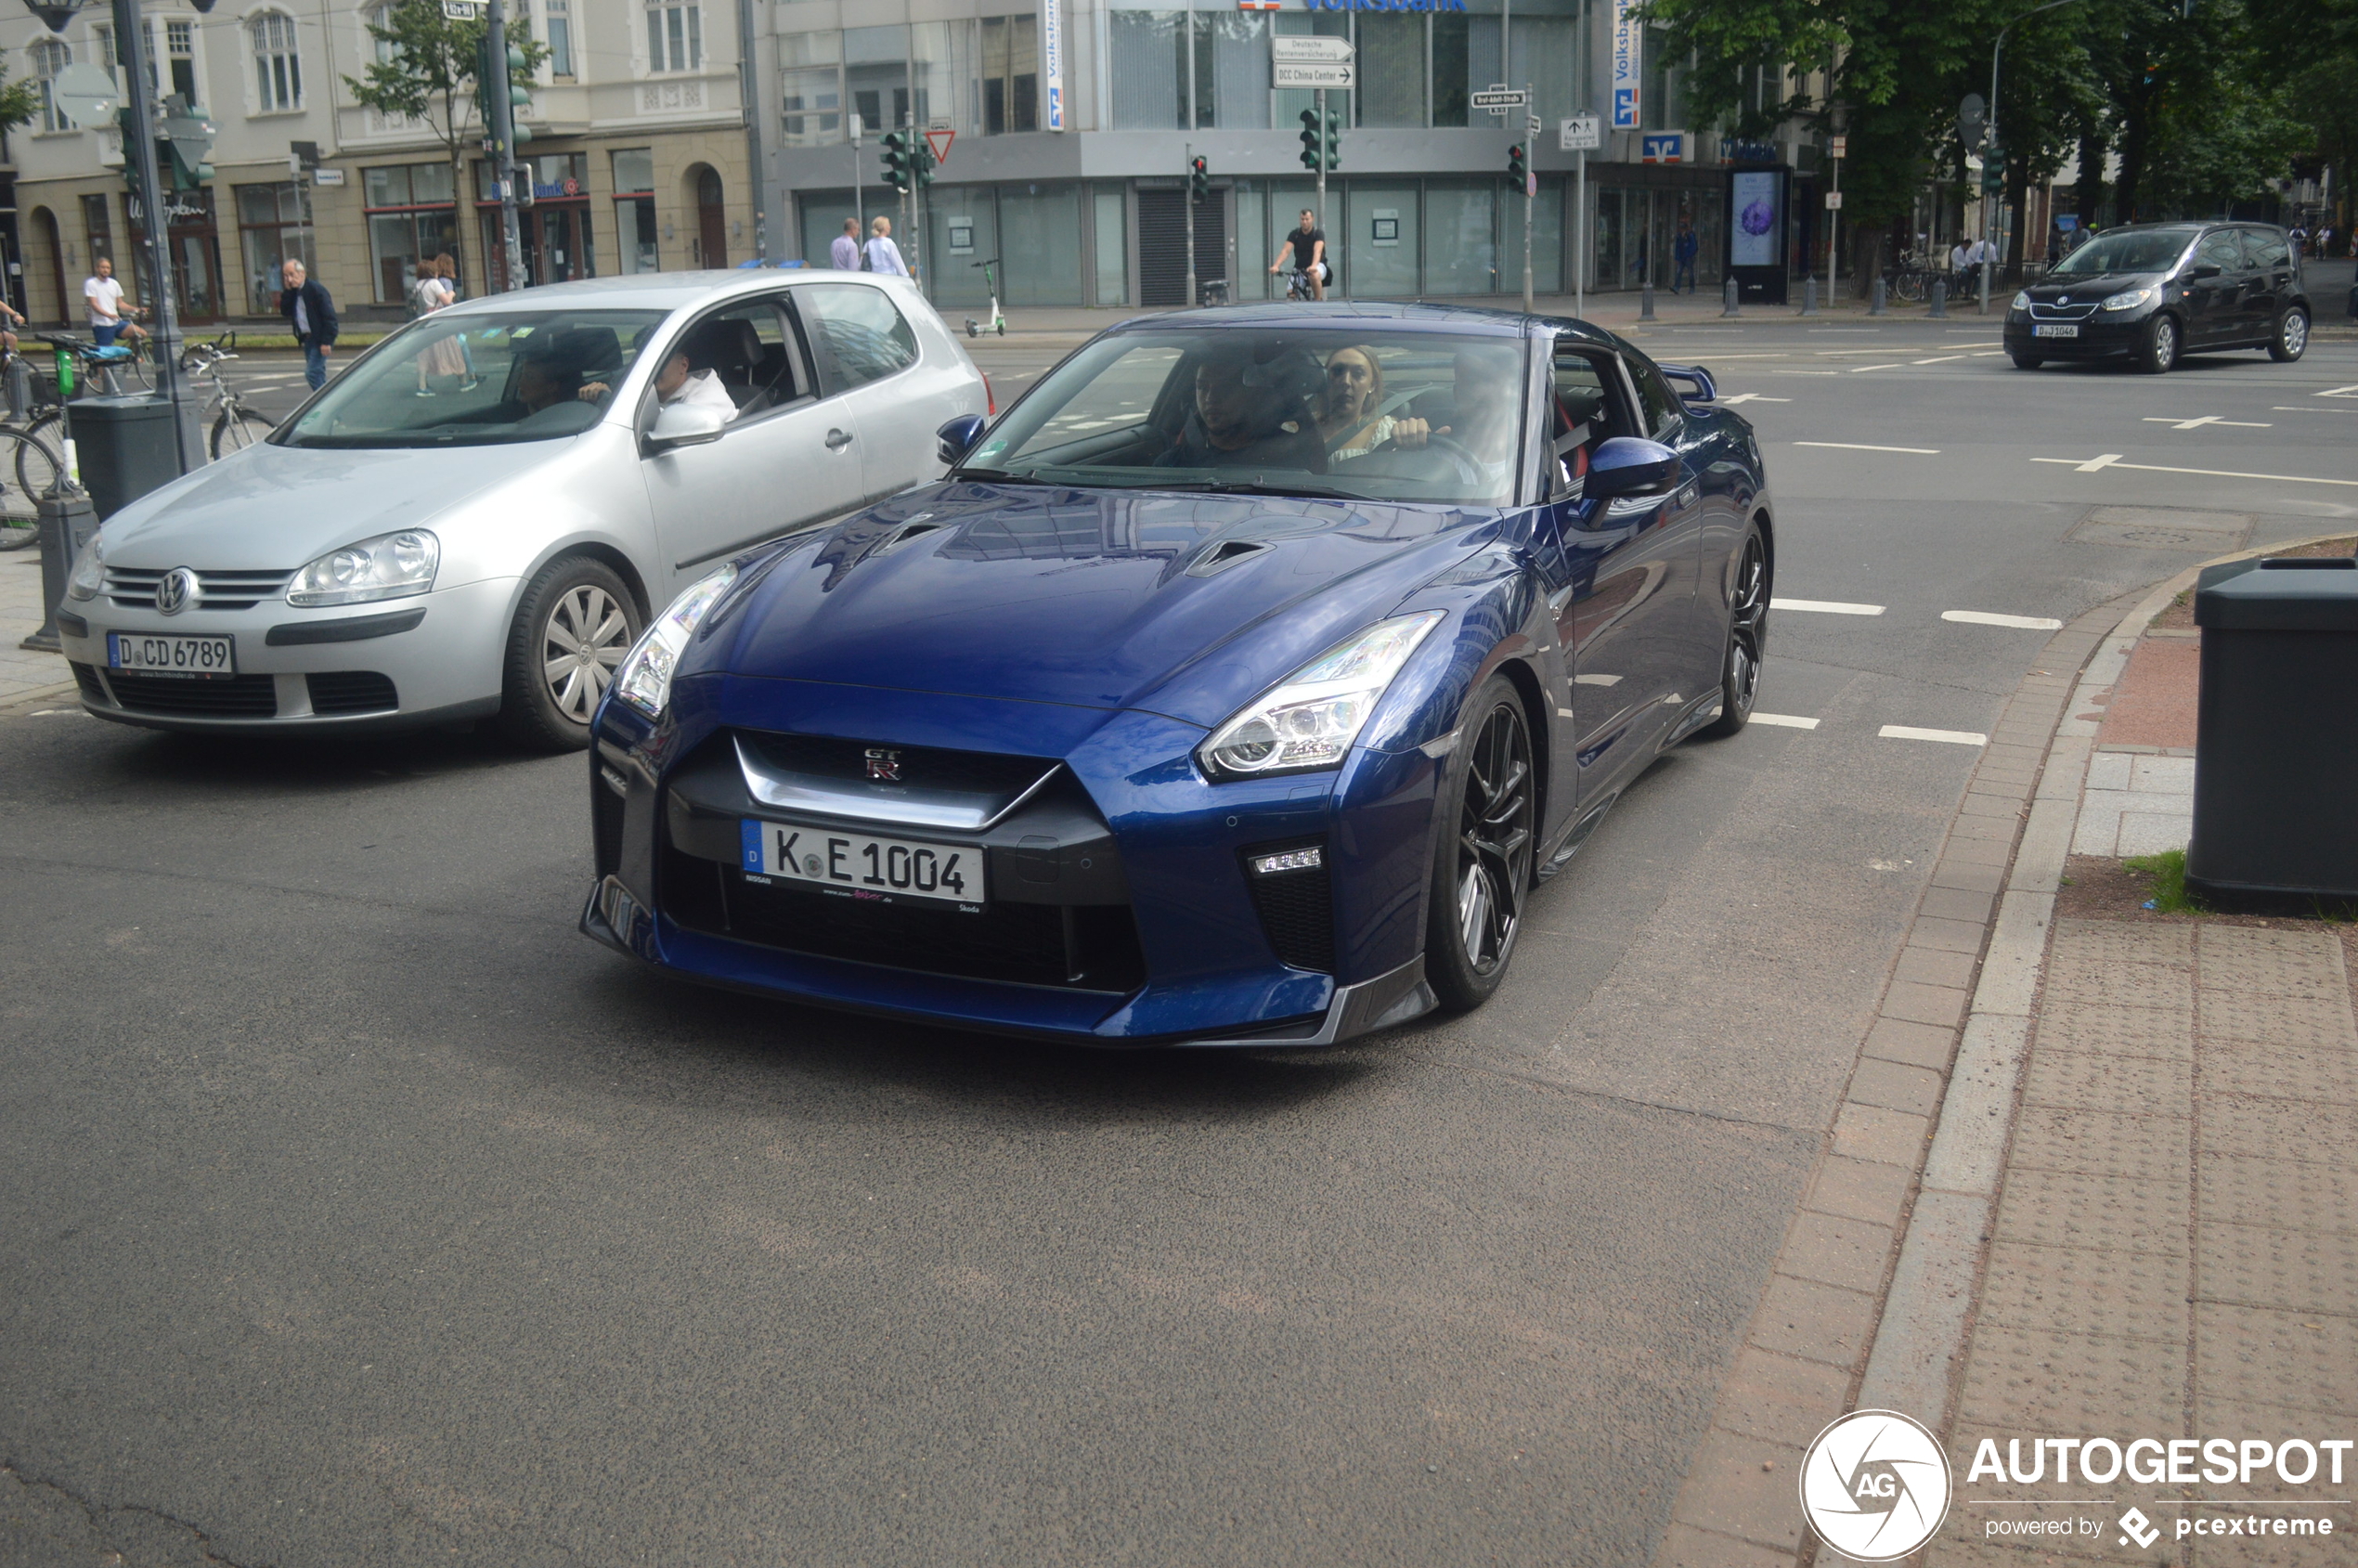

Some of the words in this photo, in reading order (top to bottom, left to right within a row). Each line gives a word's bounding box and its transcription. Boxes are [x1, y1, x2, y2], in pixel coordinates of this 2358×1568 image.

[1292, 40, 1322, 48] Deutsche
[1276, 49, 1338, 59] Rentenversicherung
[1278, 70, 1292, 80] DCC
[1294, 70, 1313, 81] China
[1315, 70, 1337, 81] Center
[120, 638, 132, 664] D
[748, 850, 758, 862] D
[777, 829, 801, 874] K
[745, 874, 771, 886] NISSAN
